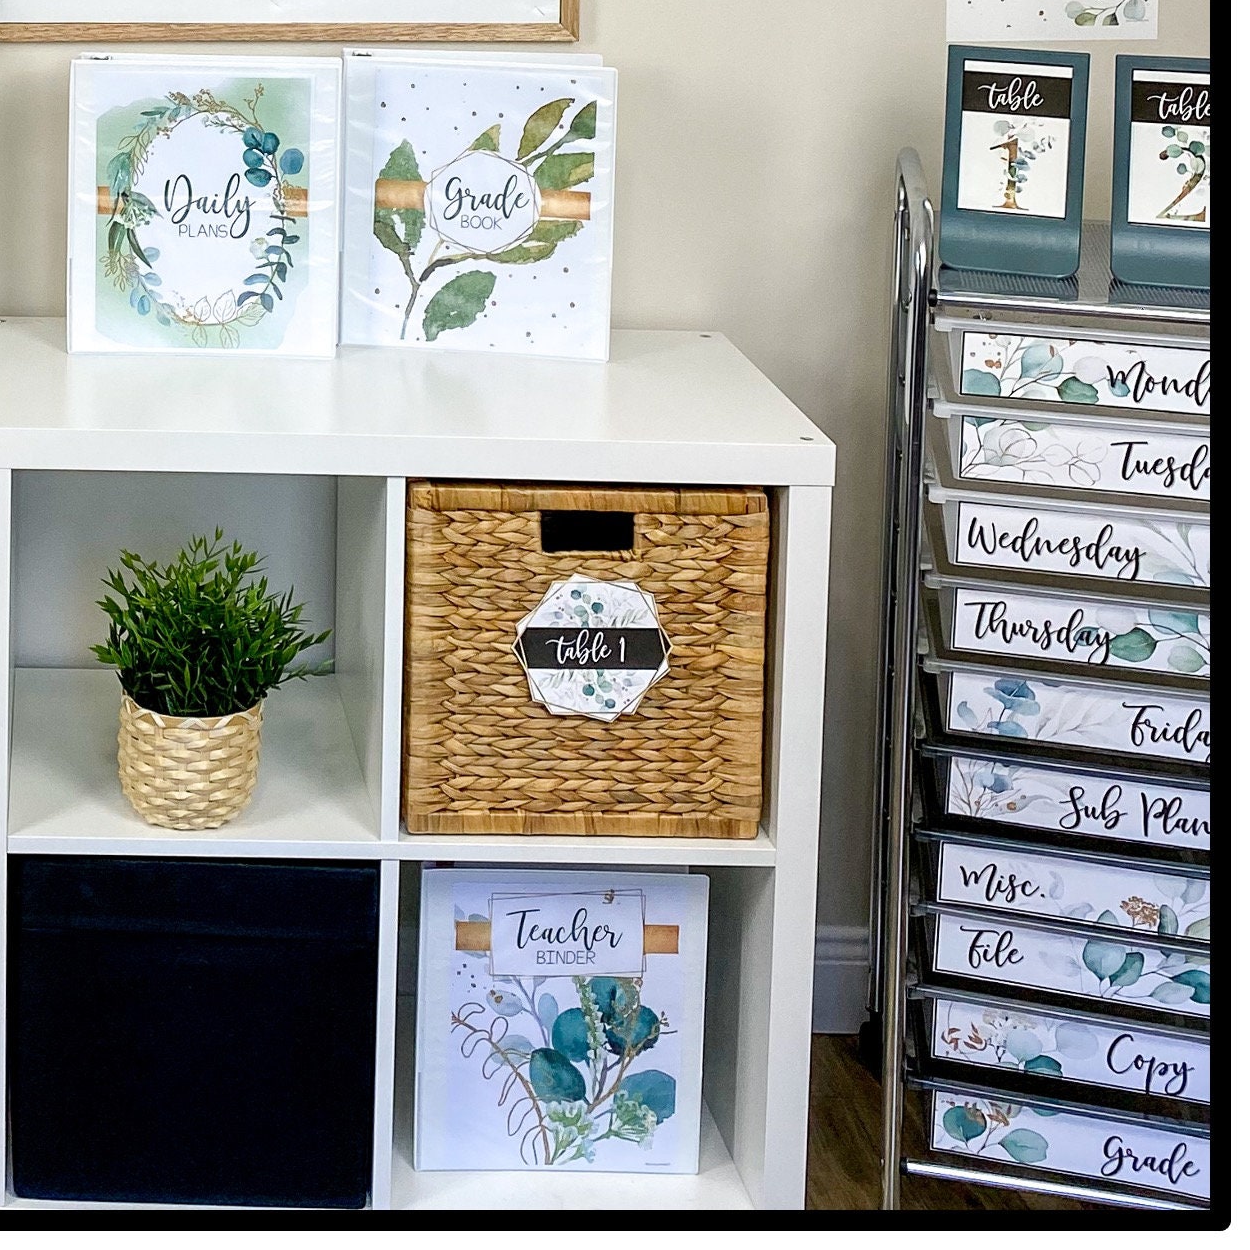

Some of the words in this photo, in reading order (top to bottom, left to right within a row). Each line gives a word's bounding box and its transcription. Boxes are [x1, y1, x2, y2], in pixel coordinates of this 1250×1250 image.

[978, 77, 1044, 110] table
[163, 172, 256, 239] Daily
[443, 175, 529, 219] Grade
[179, 225, 228, 238] PLANS
[460, 214, 502, 230] BOOK
[968, 517, 1146, 581] Wednesday
[545, 629, 612, 666] table
[618, 636, 626, 664] 1
[964, 601, 1112, 665] Thursday
[1059, 785, 1128, 830] Sub
[960, 863, 1045, 902] Misc.
[506, 906, 623, 949] Teacher
[960, 926, 1024, 968] File
[536, 950, 596, 965] BINDER
[1107, 1034, 1195, 1095] Copy
[1100, 1136, 1200, 1184] Grade
